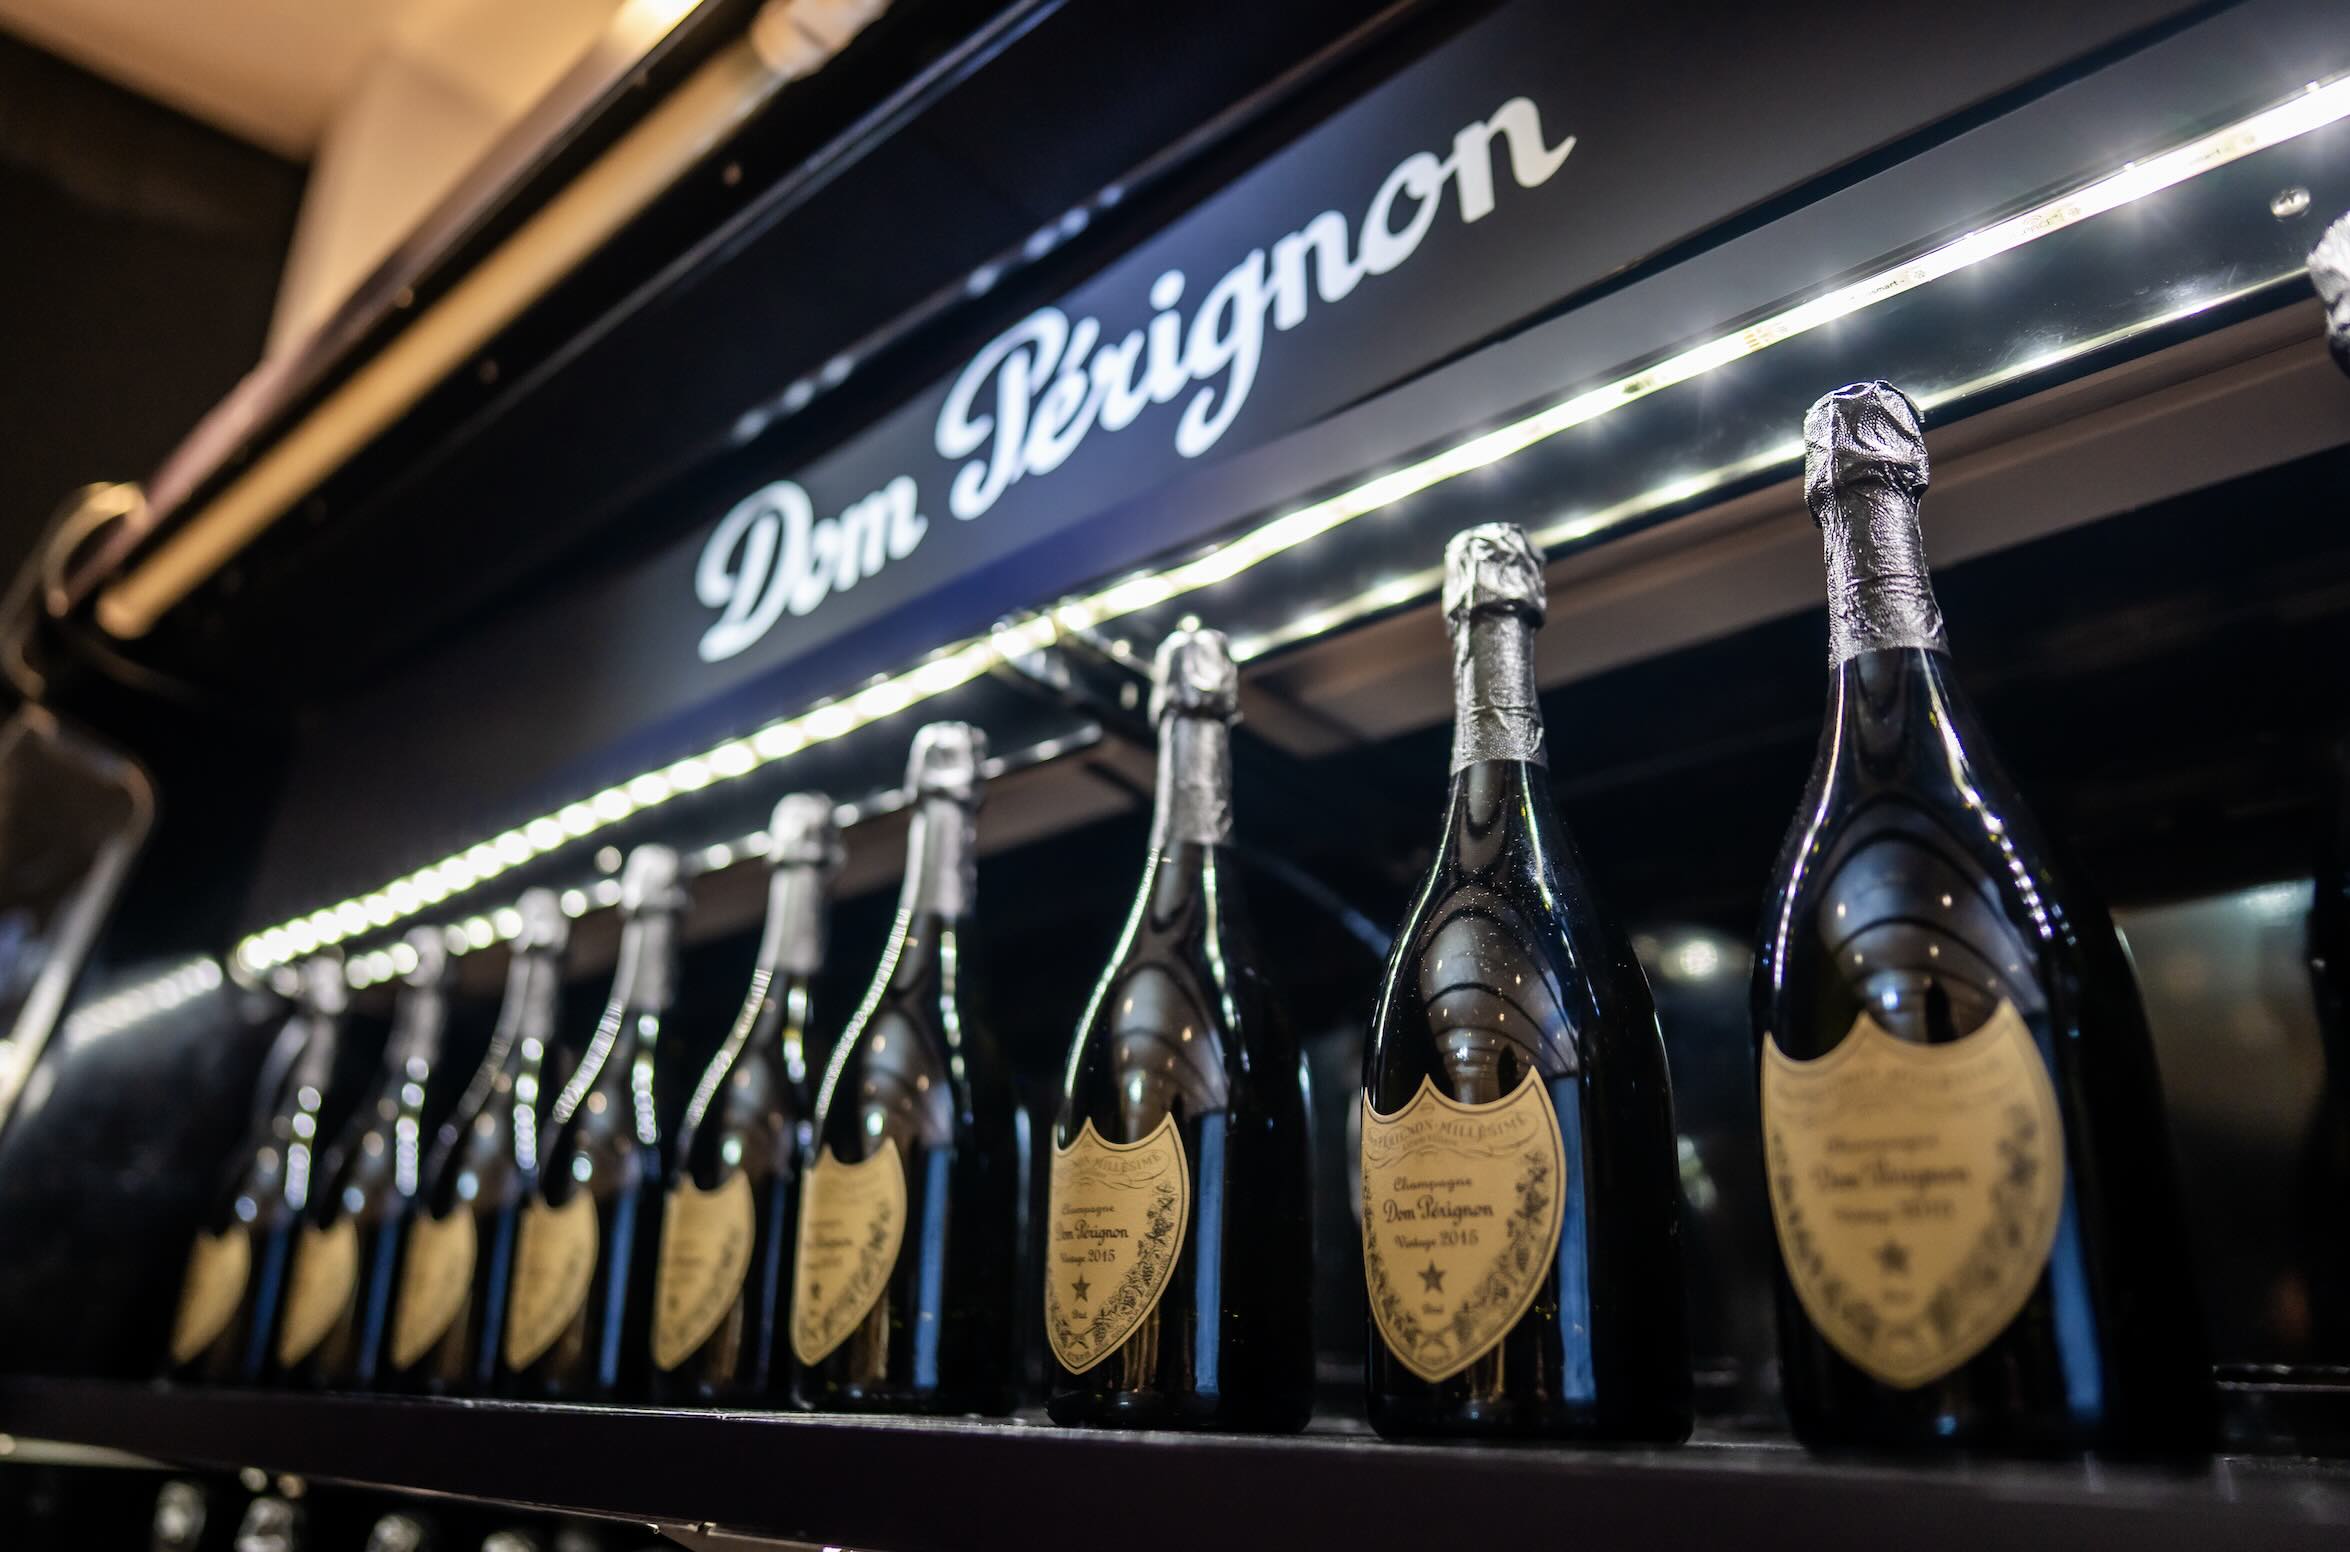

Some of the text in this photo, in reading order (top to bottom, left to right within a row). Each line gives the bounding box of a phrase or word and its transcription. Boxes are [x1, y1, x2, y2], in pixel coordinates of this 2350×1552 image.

[696, 97, 1576, 663] Dom Pérignon
[1383, 1194, 1494, 1227] Dom Pérignon
